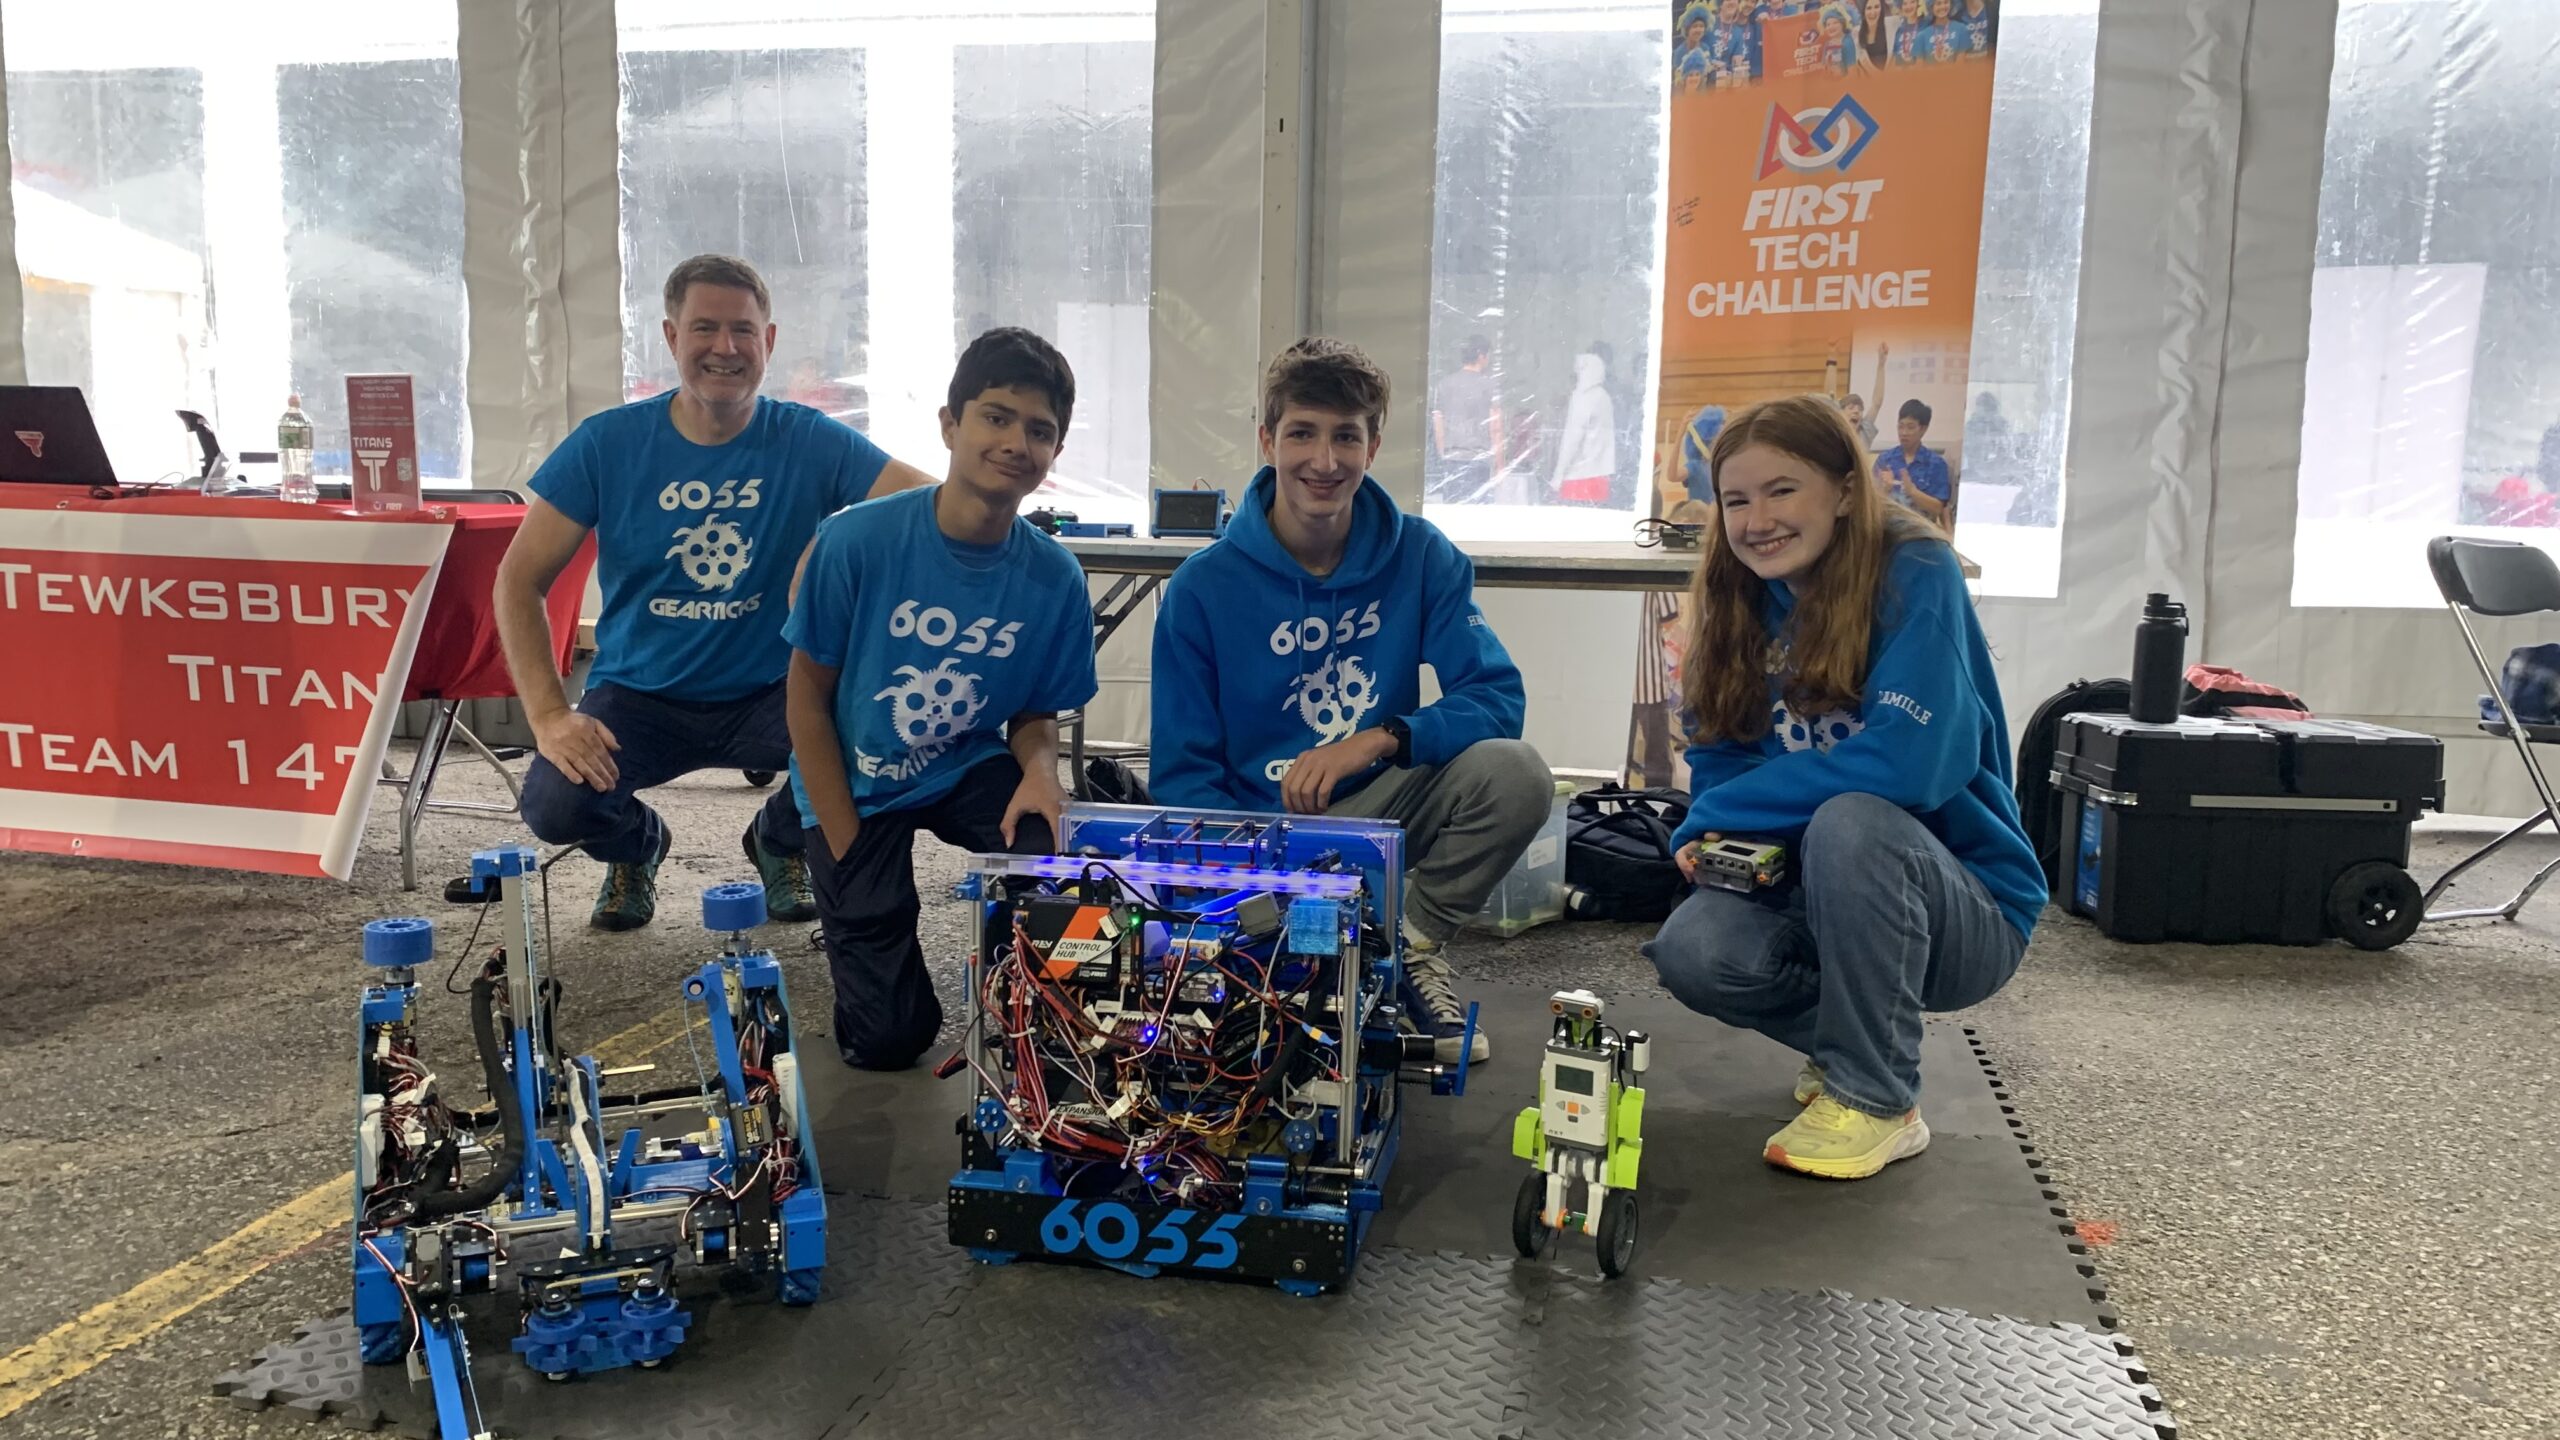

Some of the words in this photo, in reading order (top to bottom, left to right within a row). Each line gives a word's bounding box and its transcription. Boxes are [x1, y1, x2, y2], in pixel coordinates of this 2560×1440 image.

[1743, 179, 1884, 231] FIRST
[1750, 230, 1859, 272] TECH
[1687, 269, 1931, 318] CHALLENGE
[352, 437, 393, 449] TITANS
[658, 479, 764, 511] 6055
[889, 599, 1024, 658] 6055
[1269, 600, 1382, 656] 6055
[0, 722, 179, 780] TEAM
[1055, 950, 1077, 958] HUB
[1059, 942, 1101, 952] CONTROL
[1040, 1199, 1248, 1270] 6055
